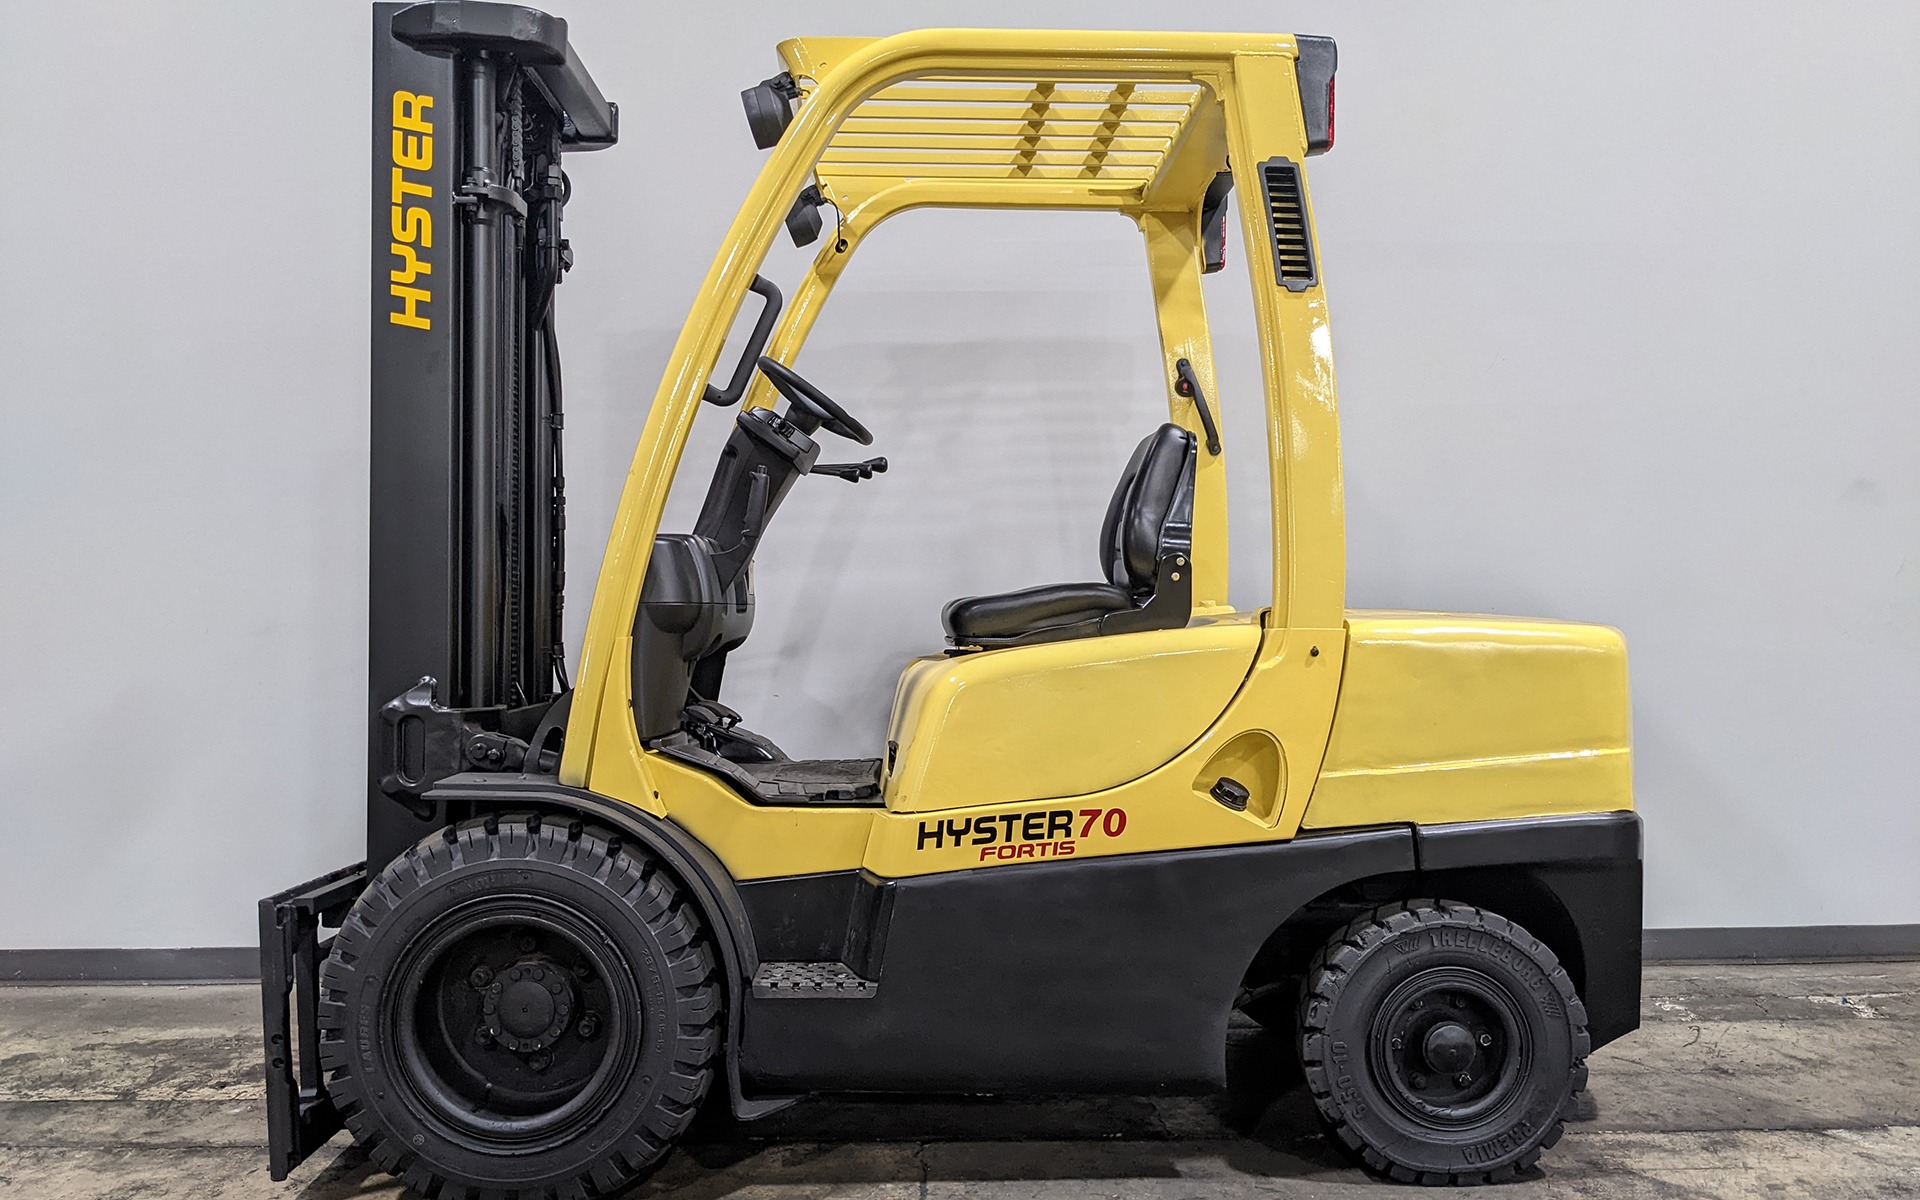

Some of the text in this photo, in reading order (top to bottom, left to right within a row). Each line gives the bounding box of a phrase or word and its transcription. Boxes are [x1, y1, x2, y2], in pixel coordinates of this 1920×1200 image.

[390, 90, 433, 331] HYSTER
[917, 808, 1127, 850] HYSTER 70
[979, 840, 1076, 862] FORTIS
[1461, 1118, 1539, 1166] PREMIA
